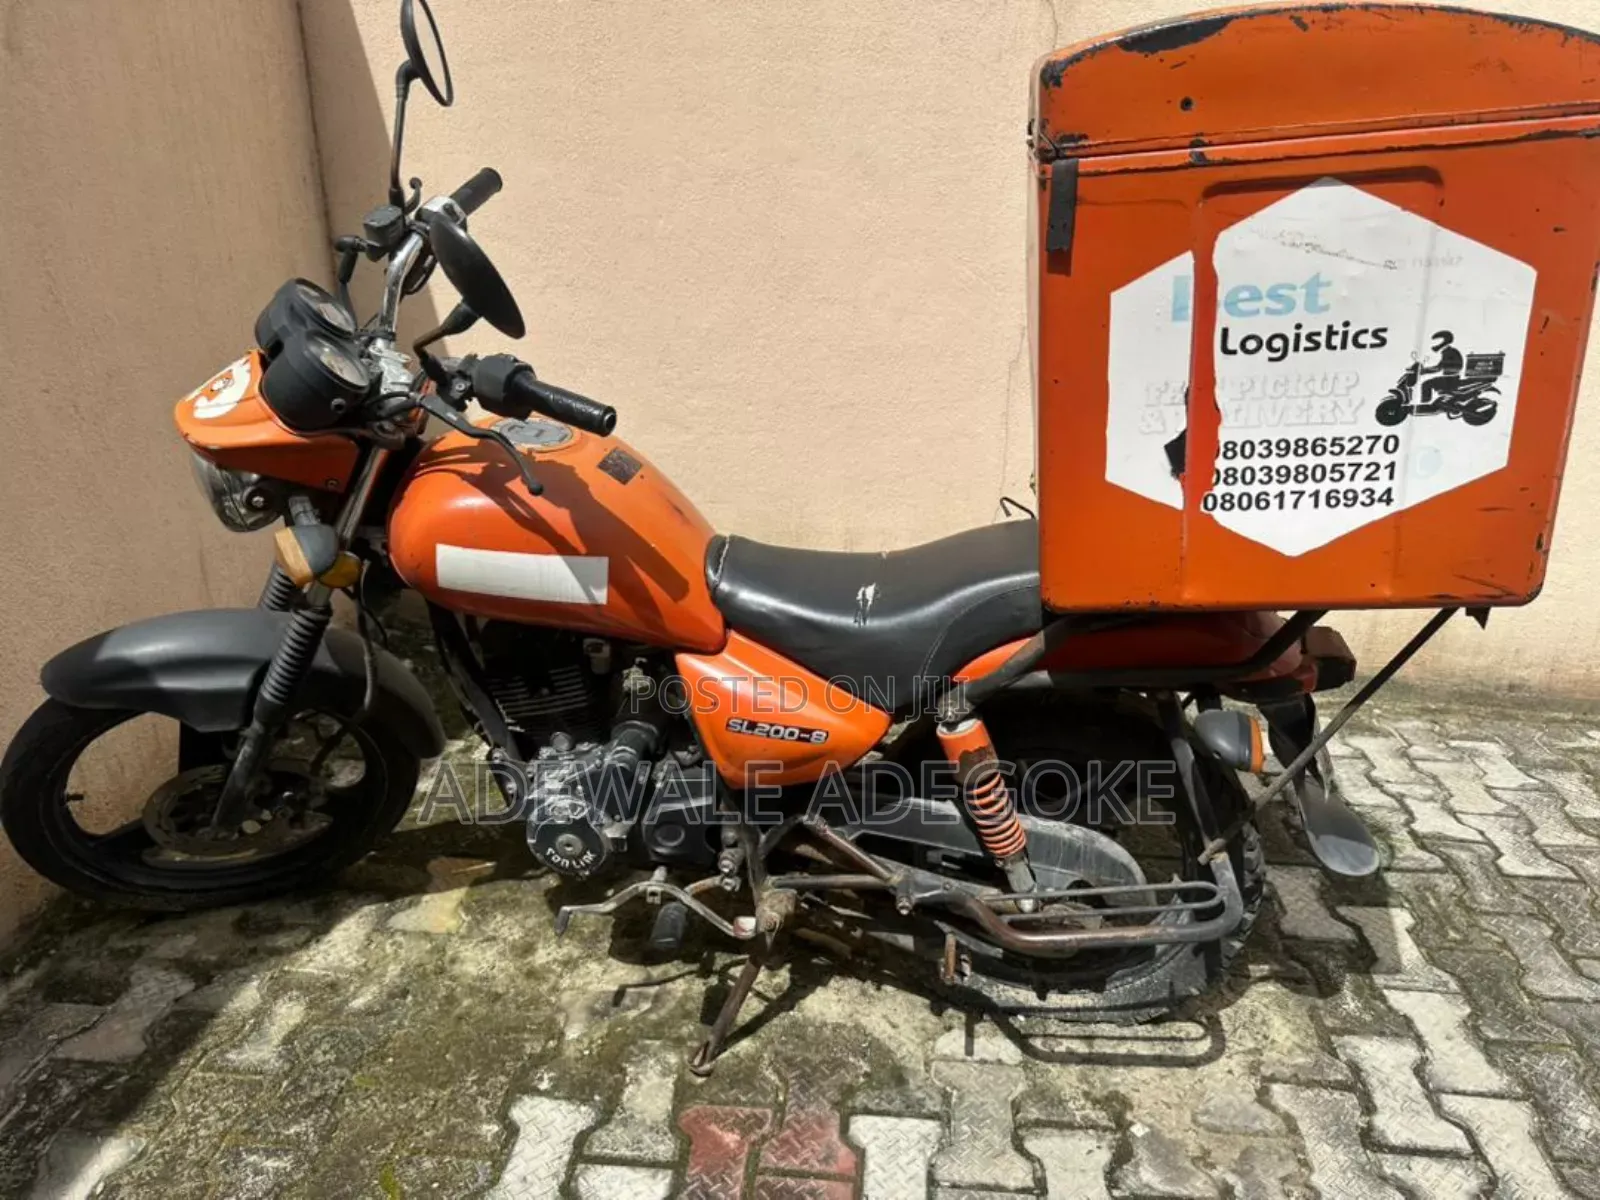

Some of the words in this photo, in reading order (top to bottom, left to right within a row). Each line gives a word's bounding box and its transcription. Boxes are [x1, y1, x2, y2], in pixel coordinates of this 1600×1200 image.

[1219, 320, 1388, 363] Logistics
[1214, 434, 1400, 460] 8039865270
[1203, 487, 1394, 511] 08061716934
[727, 717, 828, 744] SL200-8
